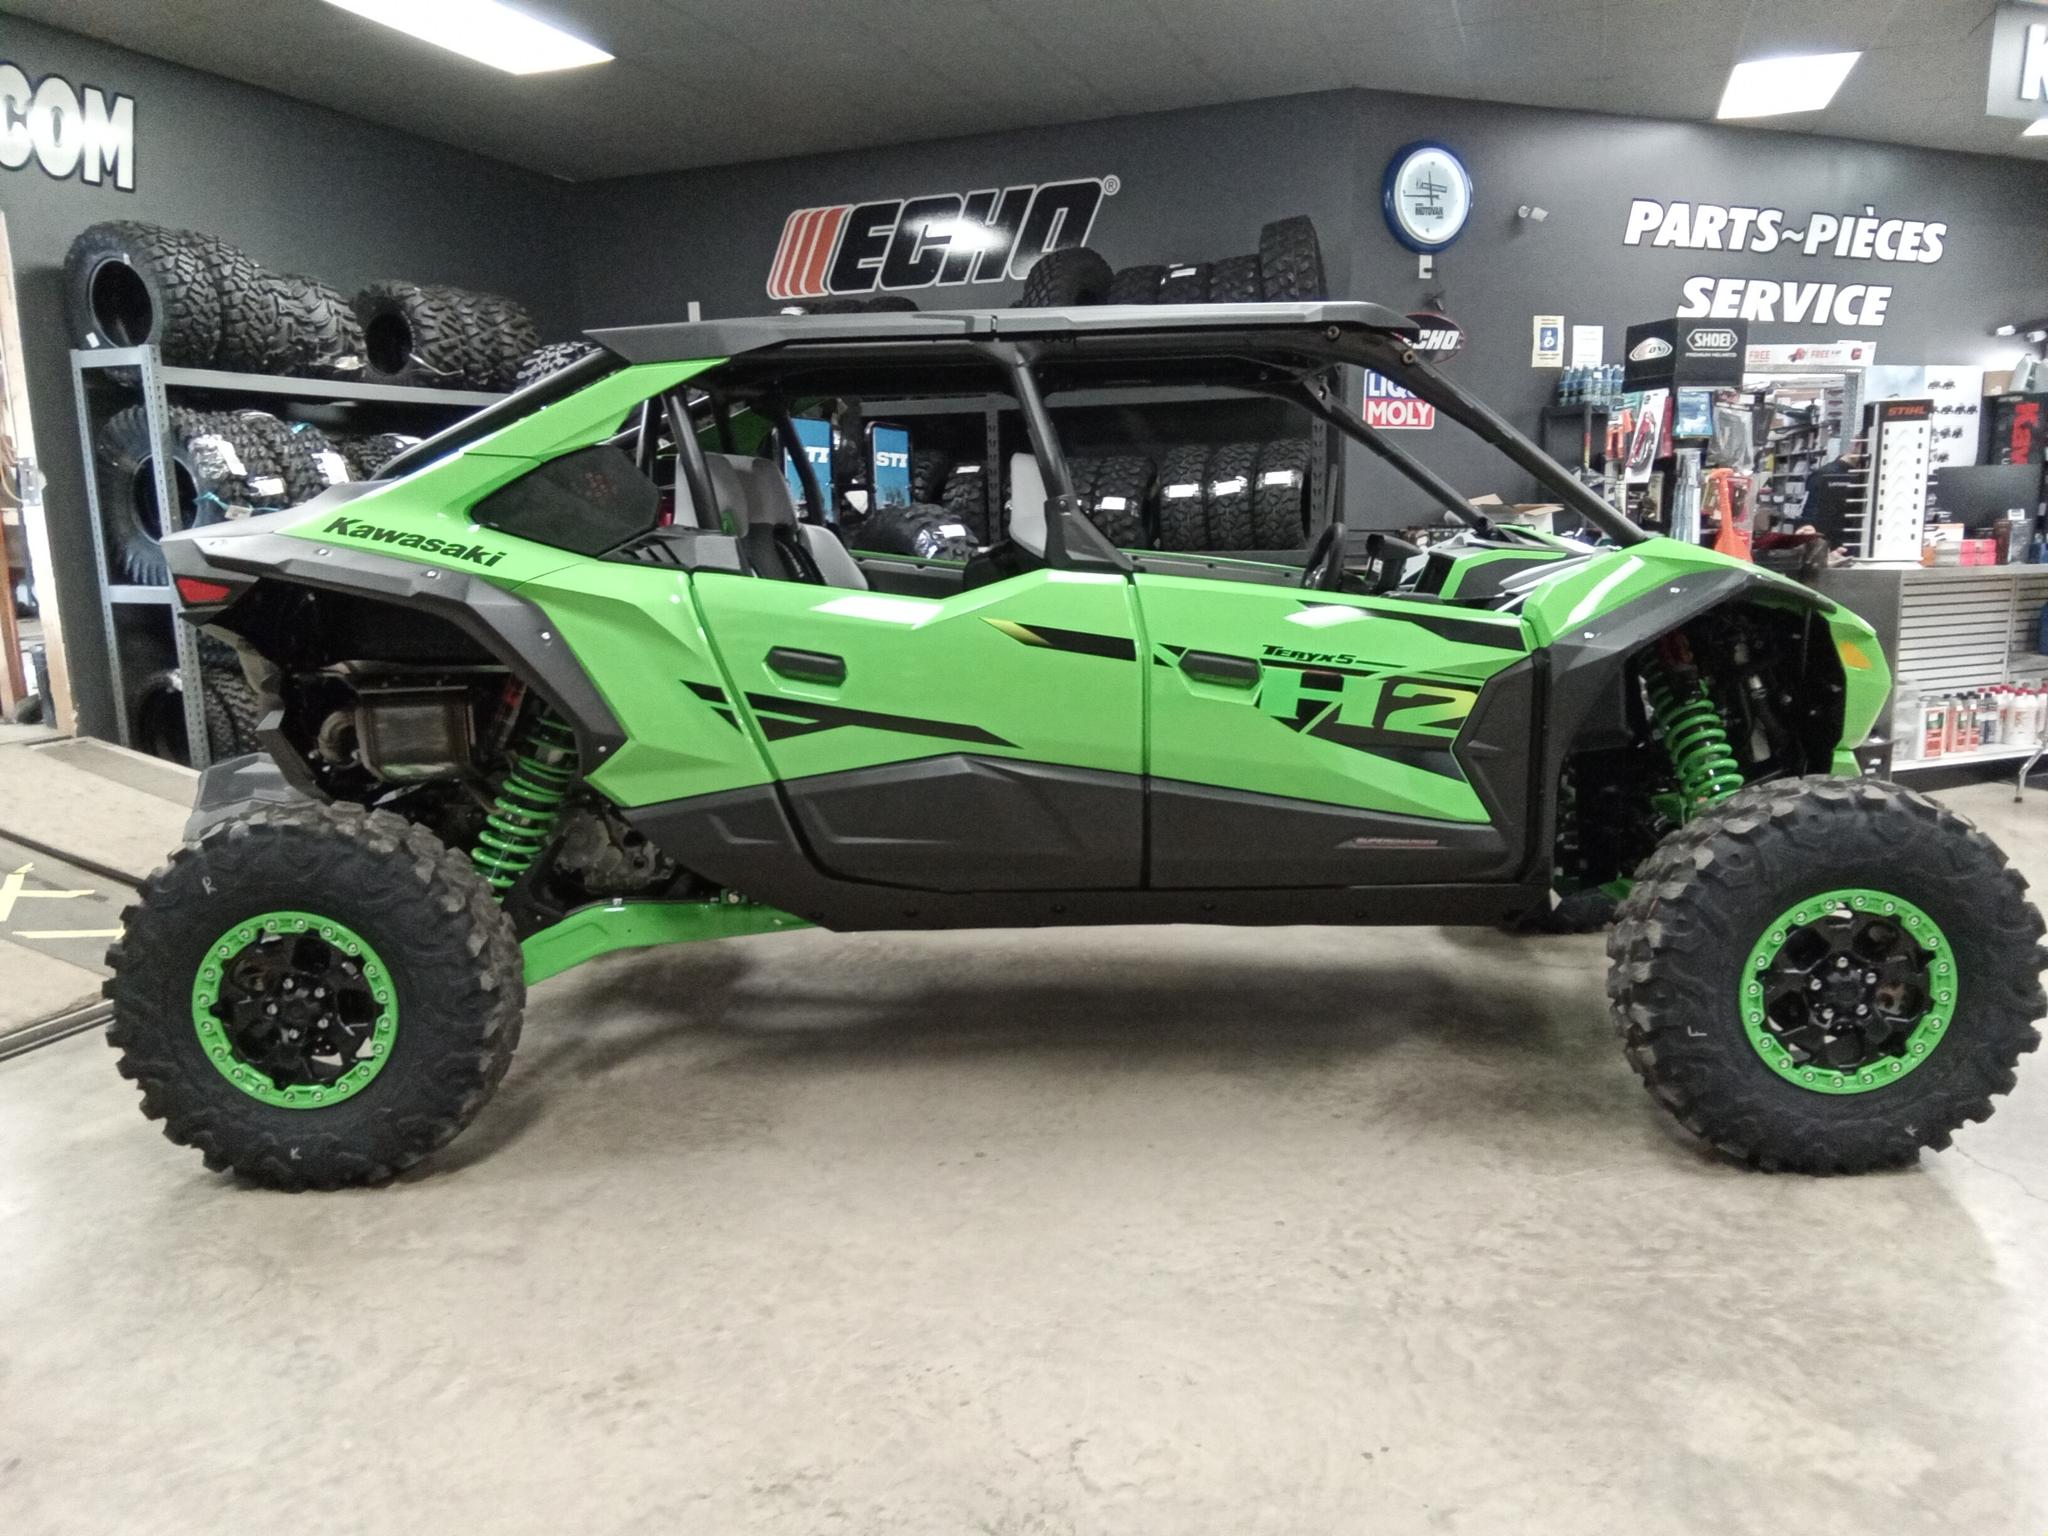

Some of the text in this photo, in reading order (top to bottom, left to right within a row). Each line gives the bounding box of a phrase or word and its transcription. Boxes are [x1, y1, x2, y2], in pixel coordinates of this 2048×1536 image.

[827, 178, 1106, 296] ECHO
[1676, 276, 1893, 327] SERVICE
[1403, 329, 1460, 350] CHO
[1694, 332, 1732, 347] SHOEI
[1749, 350, 1771, 361] FREE
[1811, 349, 1830, 359] FREE
[1367, 401, 1432, 426] MOLY
[1887, 405, 1926, 416] STIHL
[323, 517, 507, 567] Kawasaki
